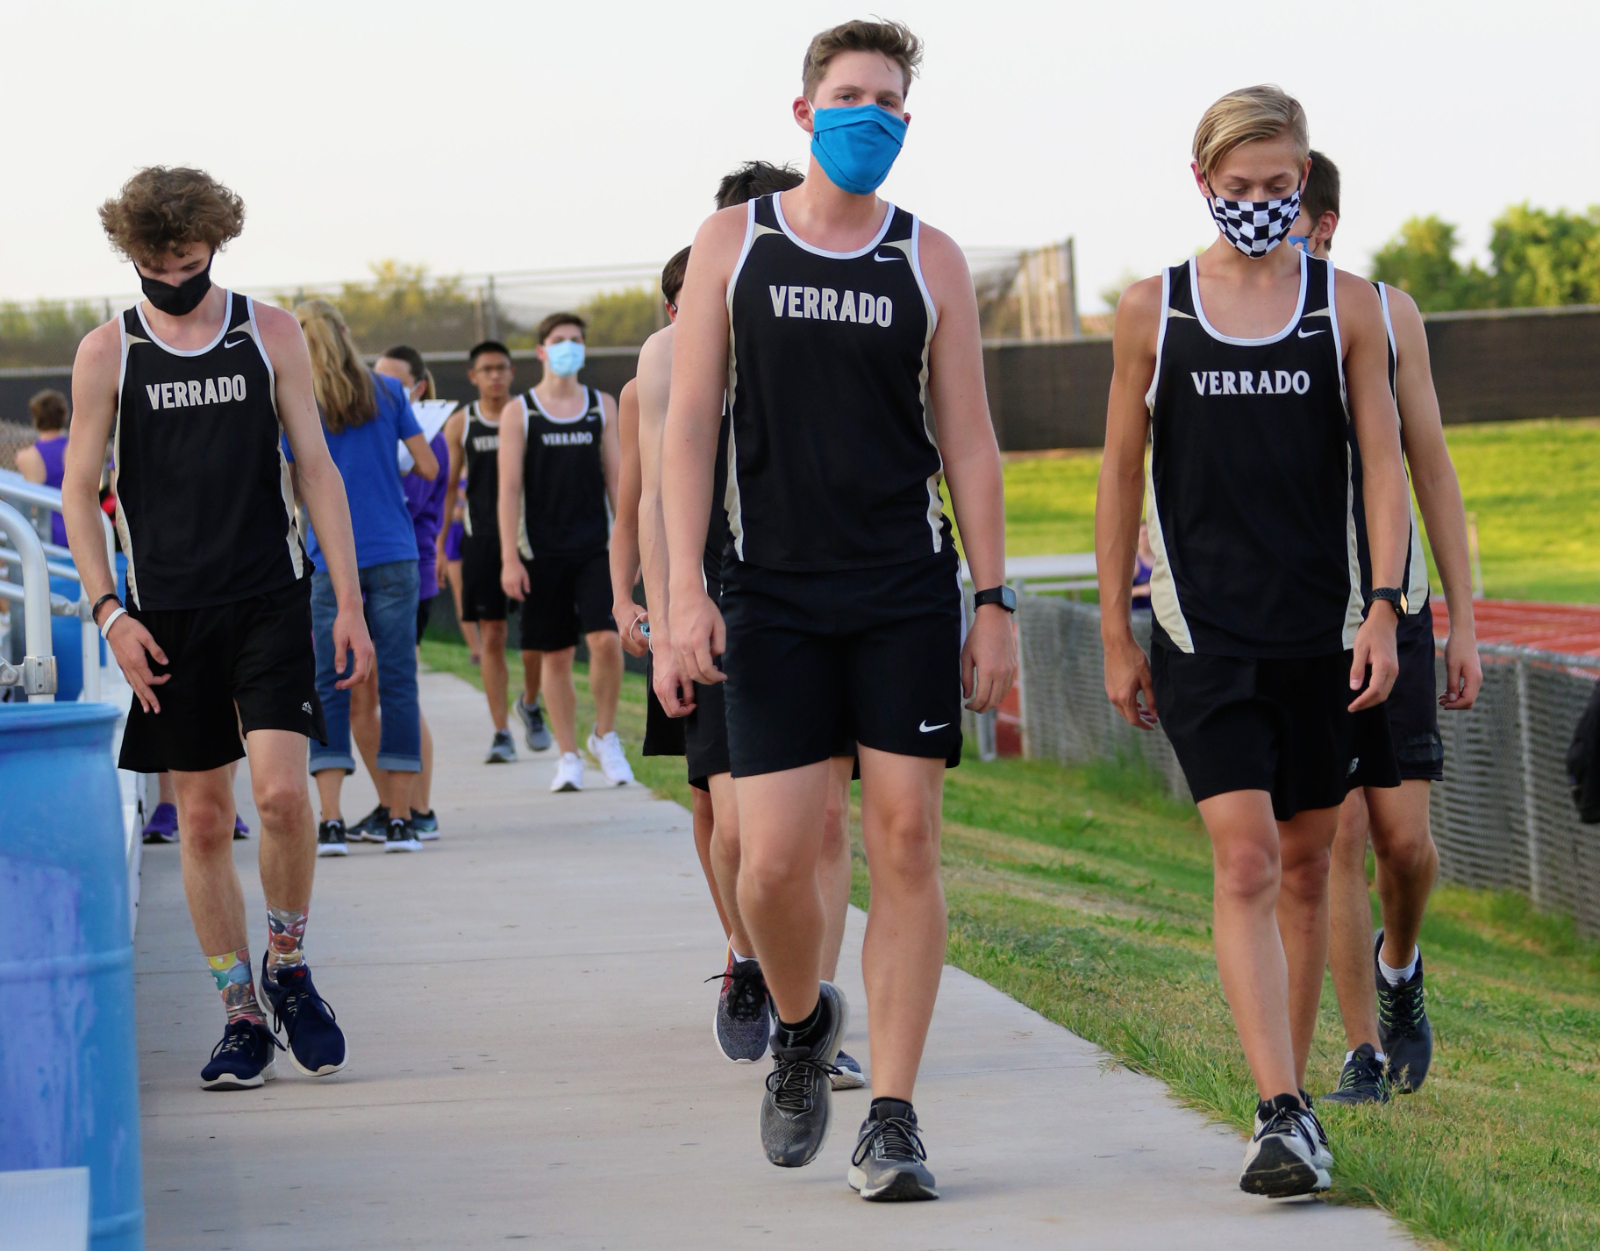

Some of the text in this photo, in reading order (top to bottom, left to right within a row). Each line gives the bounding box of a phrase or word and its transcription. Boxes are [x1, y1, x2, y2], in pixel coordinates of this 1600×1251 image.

[768, 285, 893, 328] VERRADO
[145, 374, 247, 410] VERRADO
[1190, 370, 1311, 396] VERRADO
[541, 431, 593, 446] VERRADO
